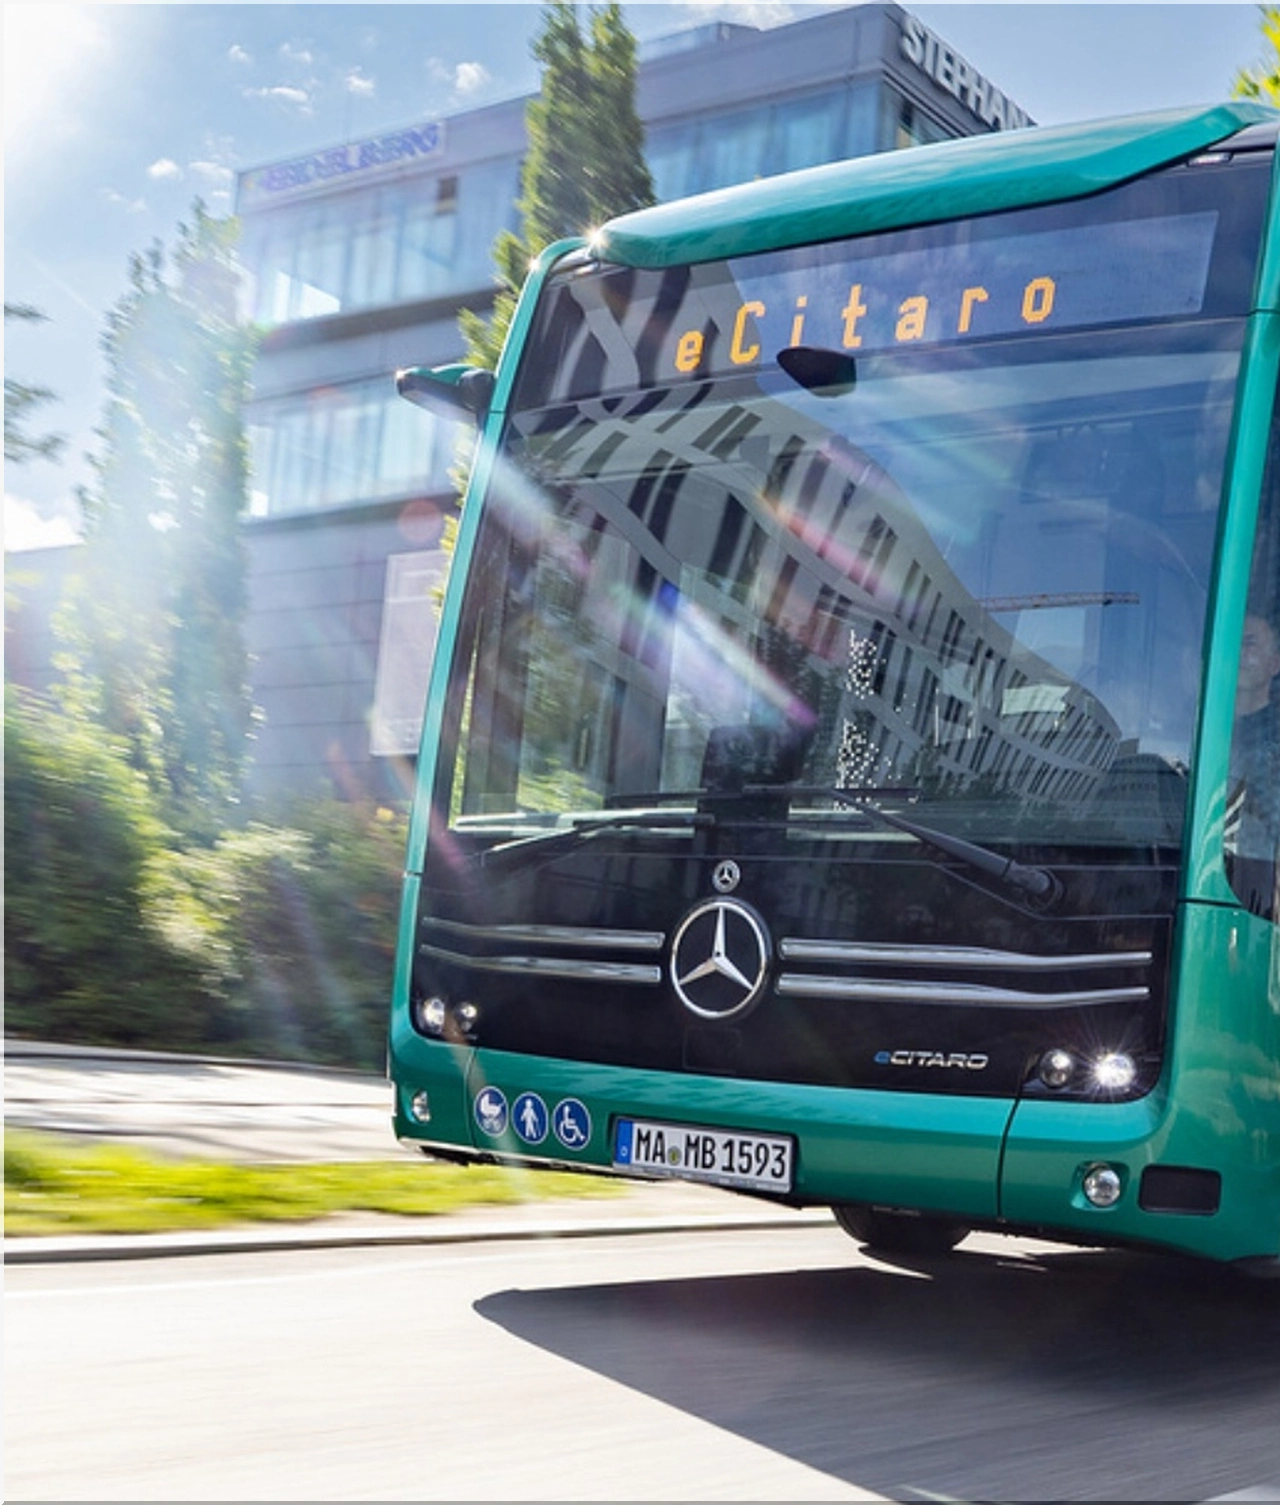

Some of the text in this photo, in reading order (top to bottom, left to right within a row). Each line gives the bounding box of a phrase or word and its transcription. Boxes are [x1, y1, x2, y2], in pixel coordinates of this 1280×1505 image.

[675, 276, 1056, 372] eCitaro
[873, 1050, 989, 1070] eCITARO
[635, 1128, 667, 1164] MA
[684, 1133, 716, 1170] MB
[721, 1138, 787, 1179] 1593
